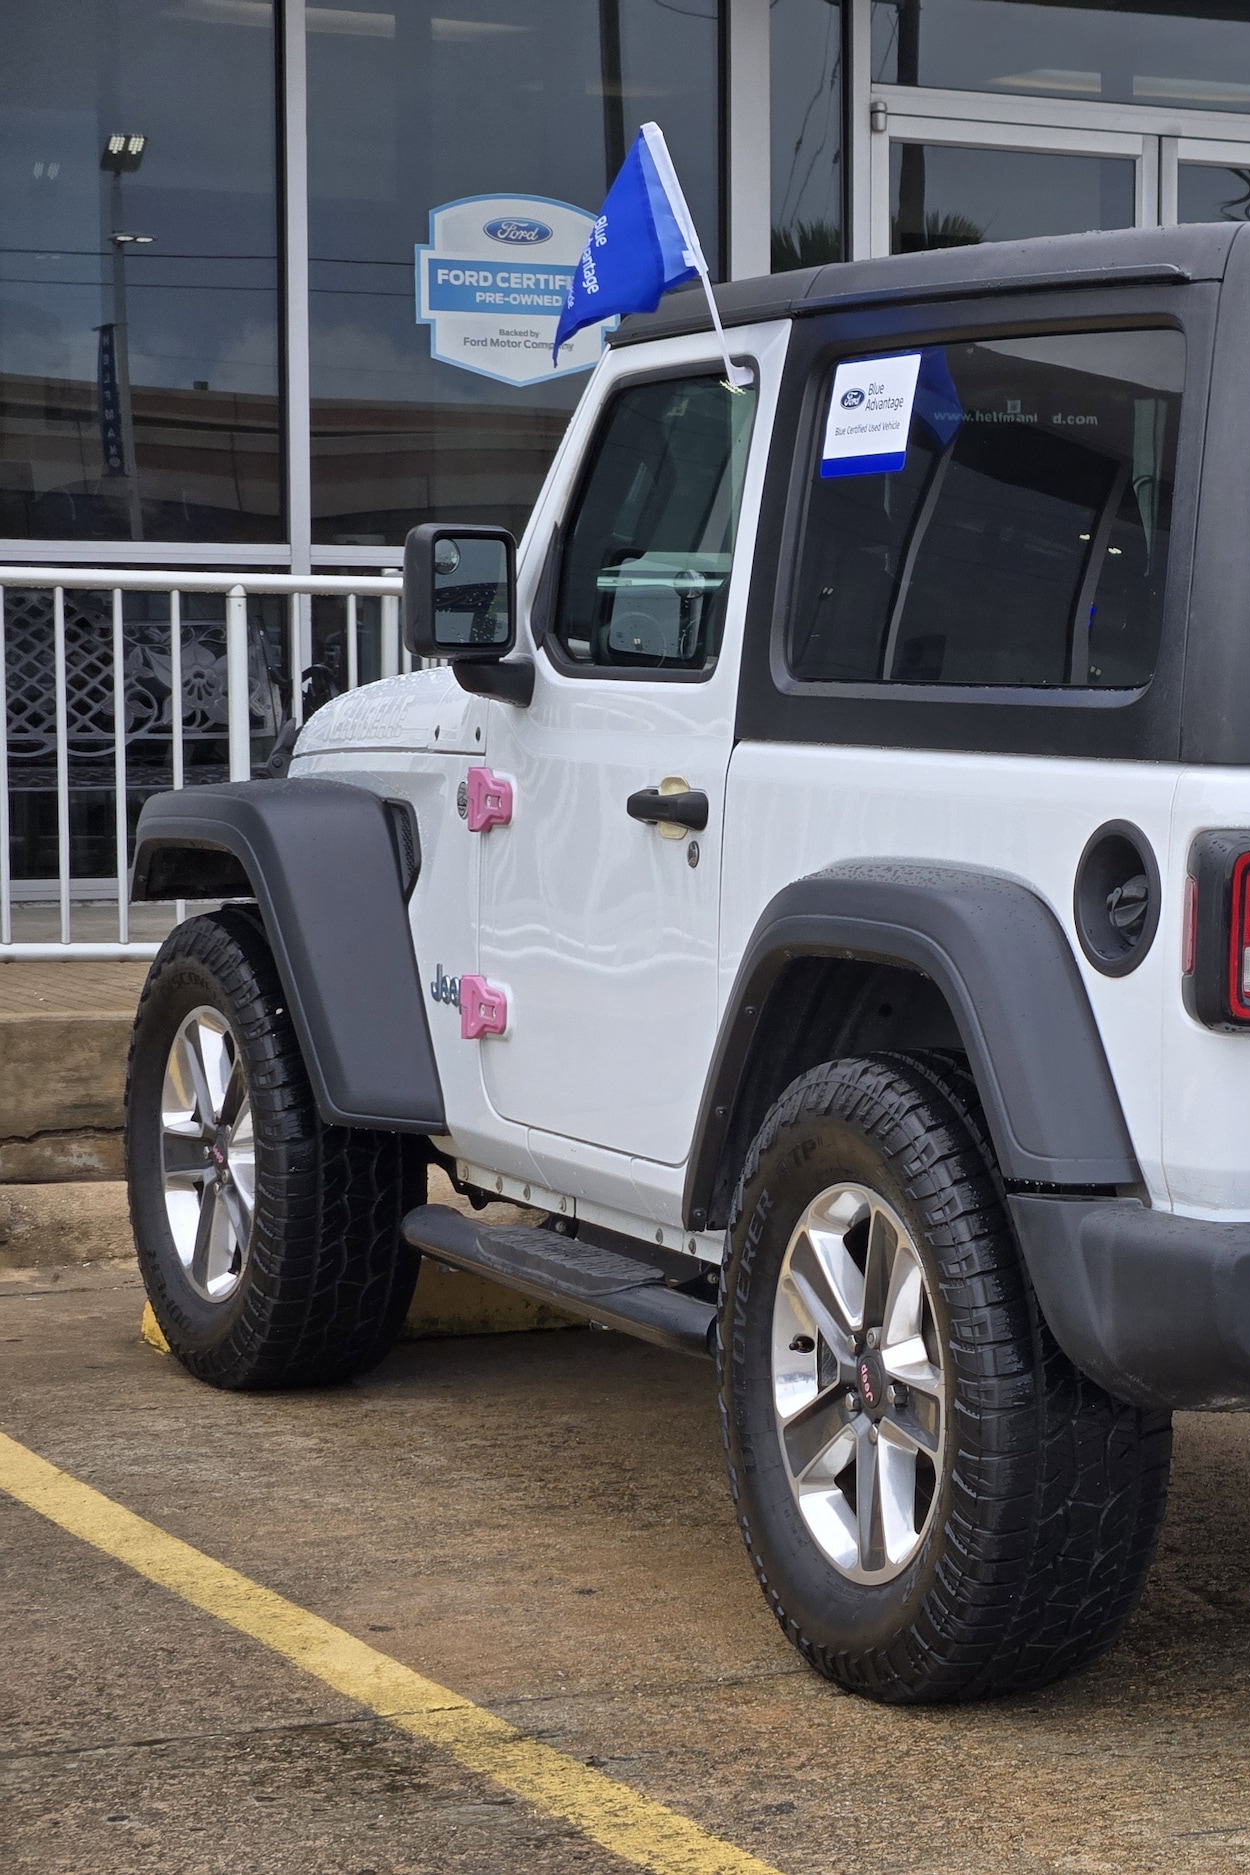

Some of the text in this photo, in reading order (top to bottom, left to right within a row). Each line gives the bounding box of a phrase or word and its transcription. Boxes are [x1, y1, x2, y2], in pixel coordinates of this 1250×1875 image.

[497, 221, 538, 241] Ford
[594, 215, 608, 247] Blue
[582, 238, 599, 295] antage
[437, 269, 573, 291] FORD CERTIFI
[475, 292, 563, 307] PRE-OWNED
[499, 328, 539, 338] Backed by
[463, 337, 488, 347] Ford
[490, 338, 521, 348] Motor
[868, 382, 884, 396] Blue
[865, 397, 904, 412] Advantage
[835, 420, 900, 436] Blue Certified Used Vehicle
[860, 1363, 874, 1403] Jeep
